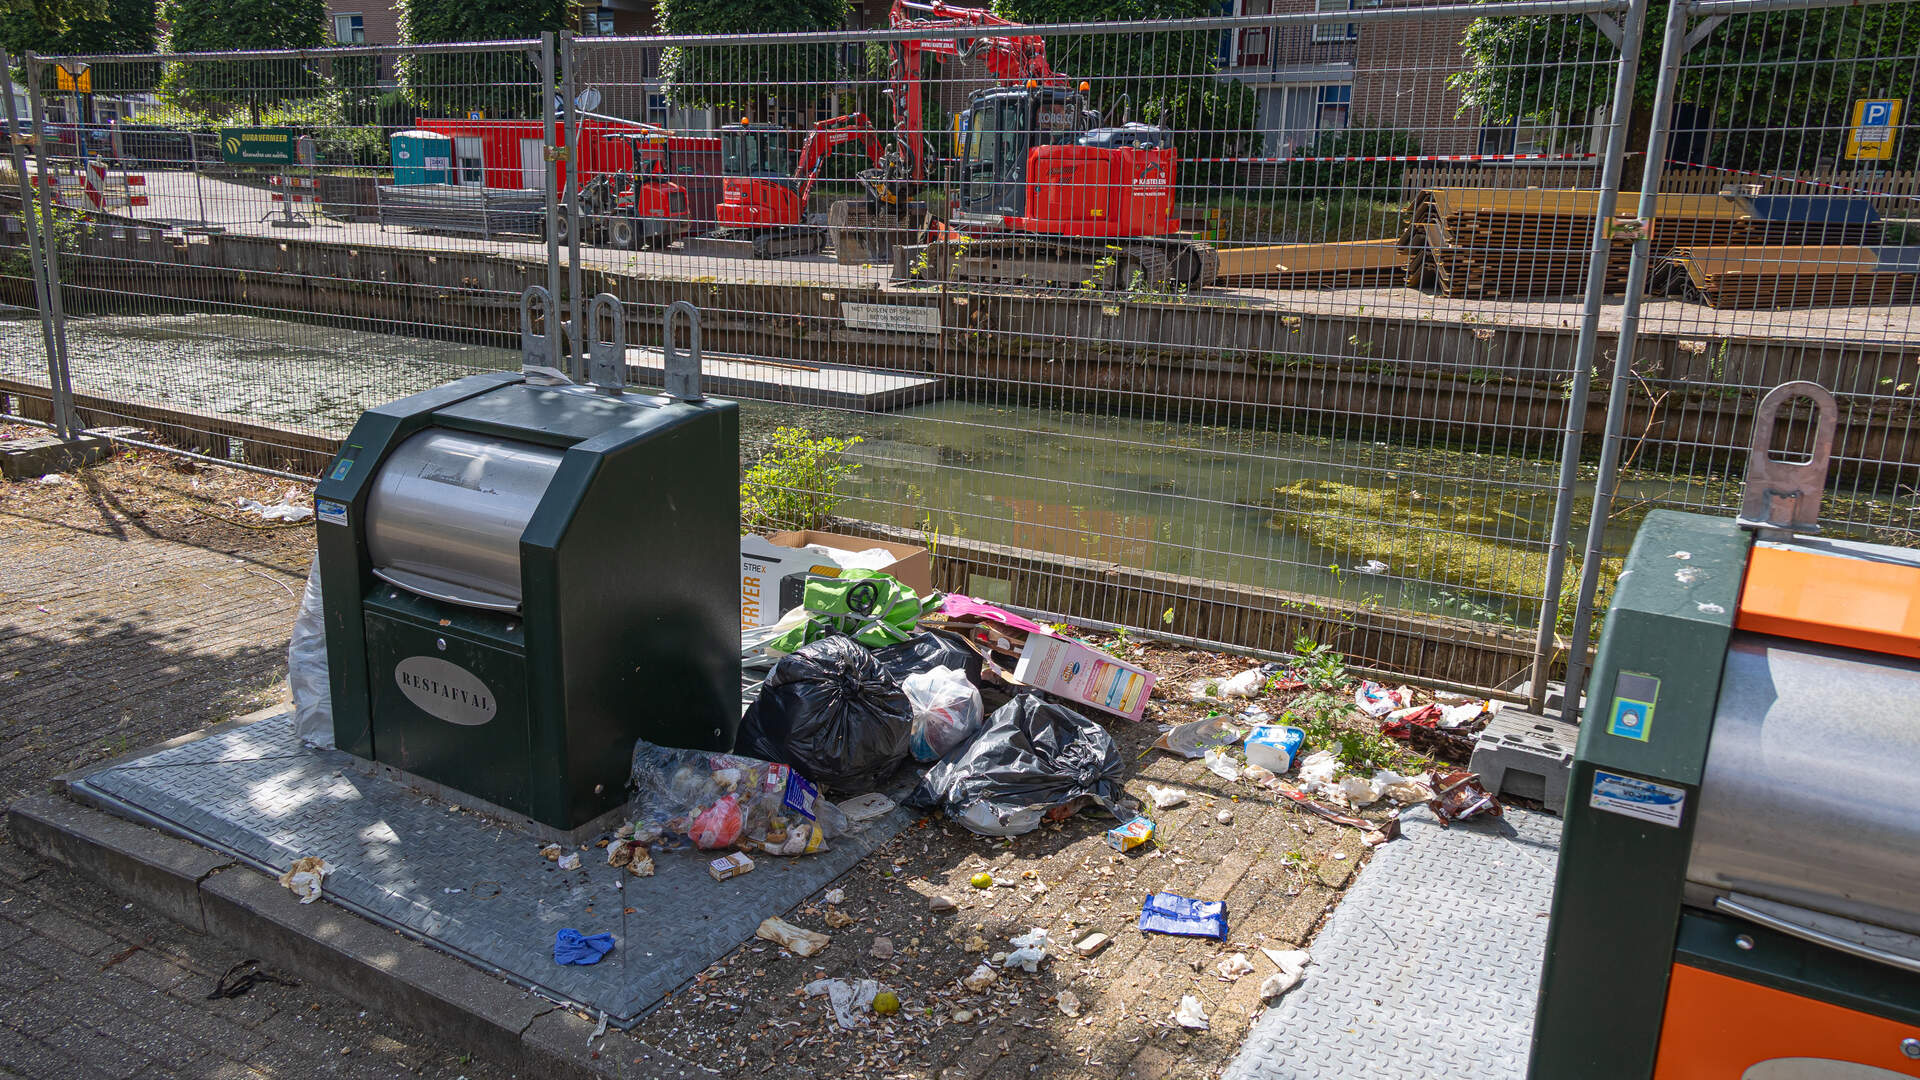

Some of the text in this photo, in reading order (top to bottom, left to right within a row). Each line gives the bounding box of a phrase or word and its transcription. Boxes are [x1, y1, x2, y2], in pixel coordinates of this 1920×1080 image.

[1868, 105, 1884, 124] P
[743, 562, 767, 574] STREX
[742, 576, 761, 629] FRYER
[402, 671, 490, 711] RESTAFVAL
